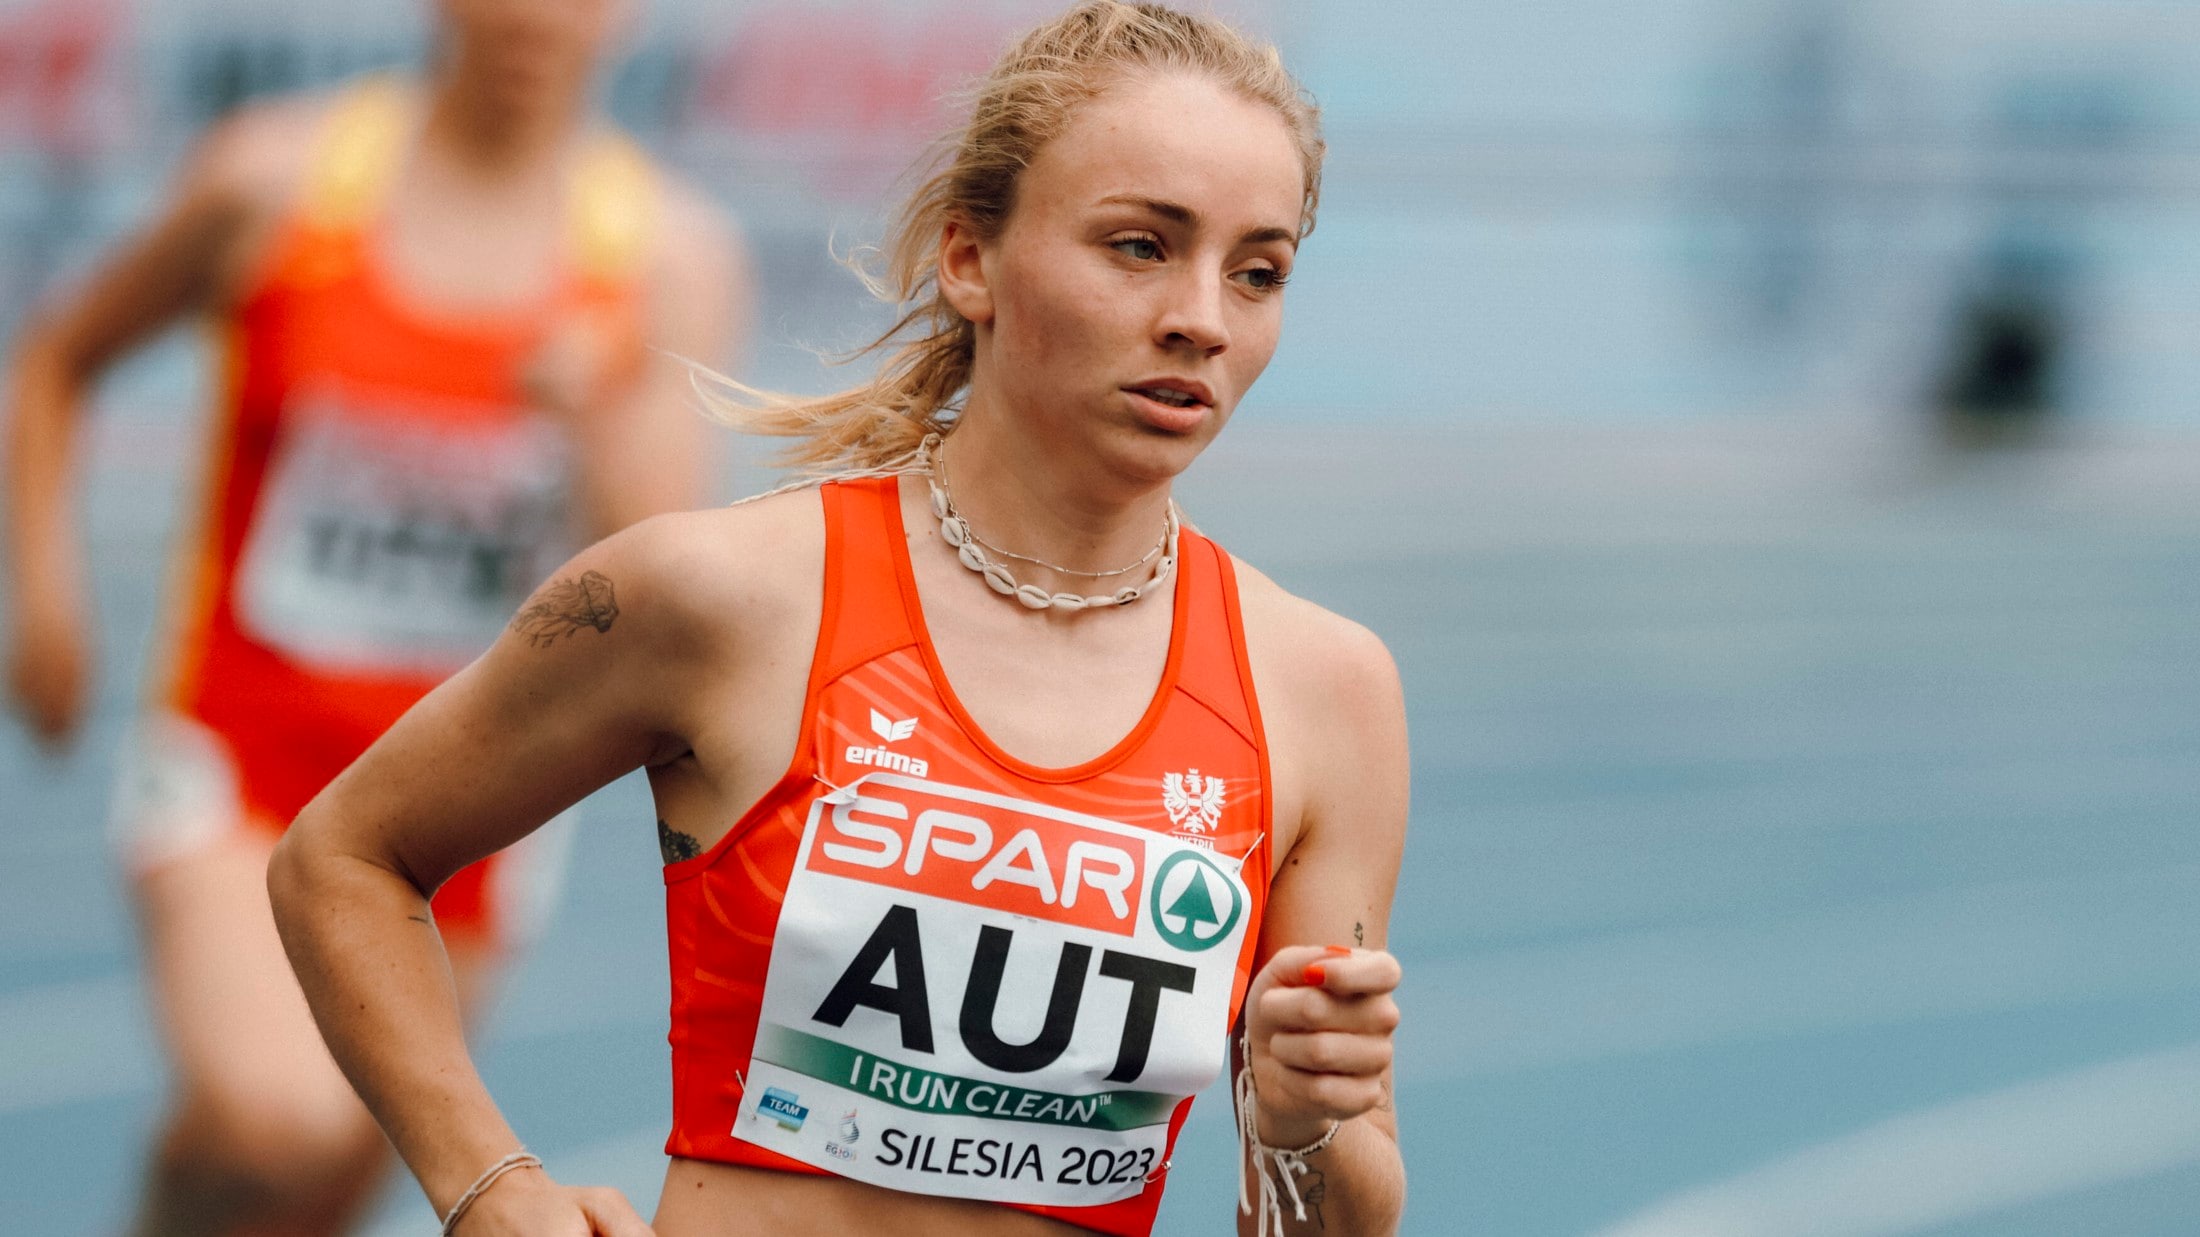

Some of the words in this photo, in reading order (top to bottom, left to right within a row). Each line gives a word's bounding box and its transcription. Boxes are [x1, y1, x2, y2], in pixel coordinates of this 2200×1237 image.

[845, 745, 928, 778] erima
[823, 800, 1135, 920] SPAR
[811, 904, 1196, 1083] AUT
[769, 1098, 801, 1117] TEAM
[850, 1055, 863, 1085] I
[869, 1062, 960, 1109] RUN
[875, 1128, 1044, 1182] SILESIA
[1057, 1146, 1156, 1186] 2023
